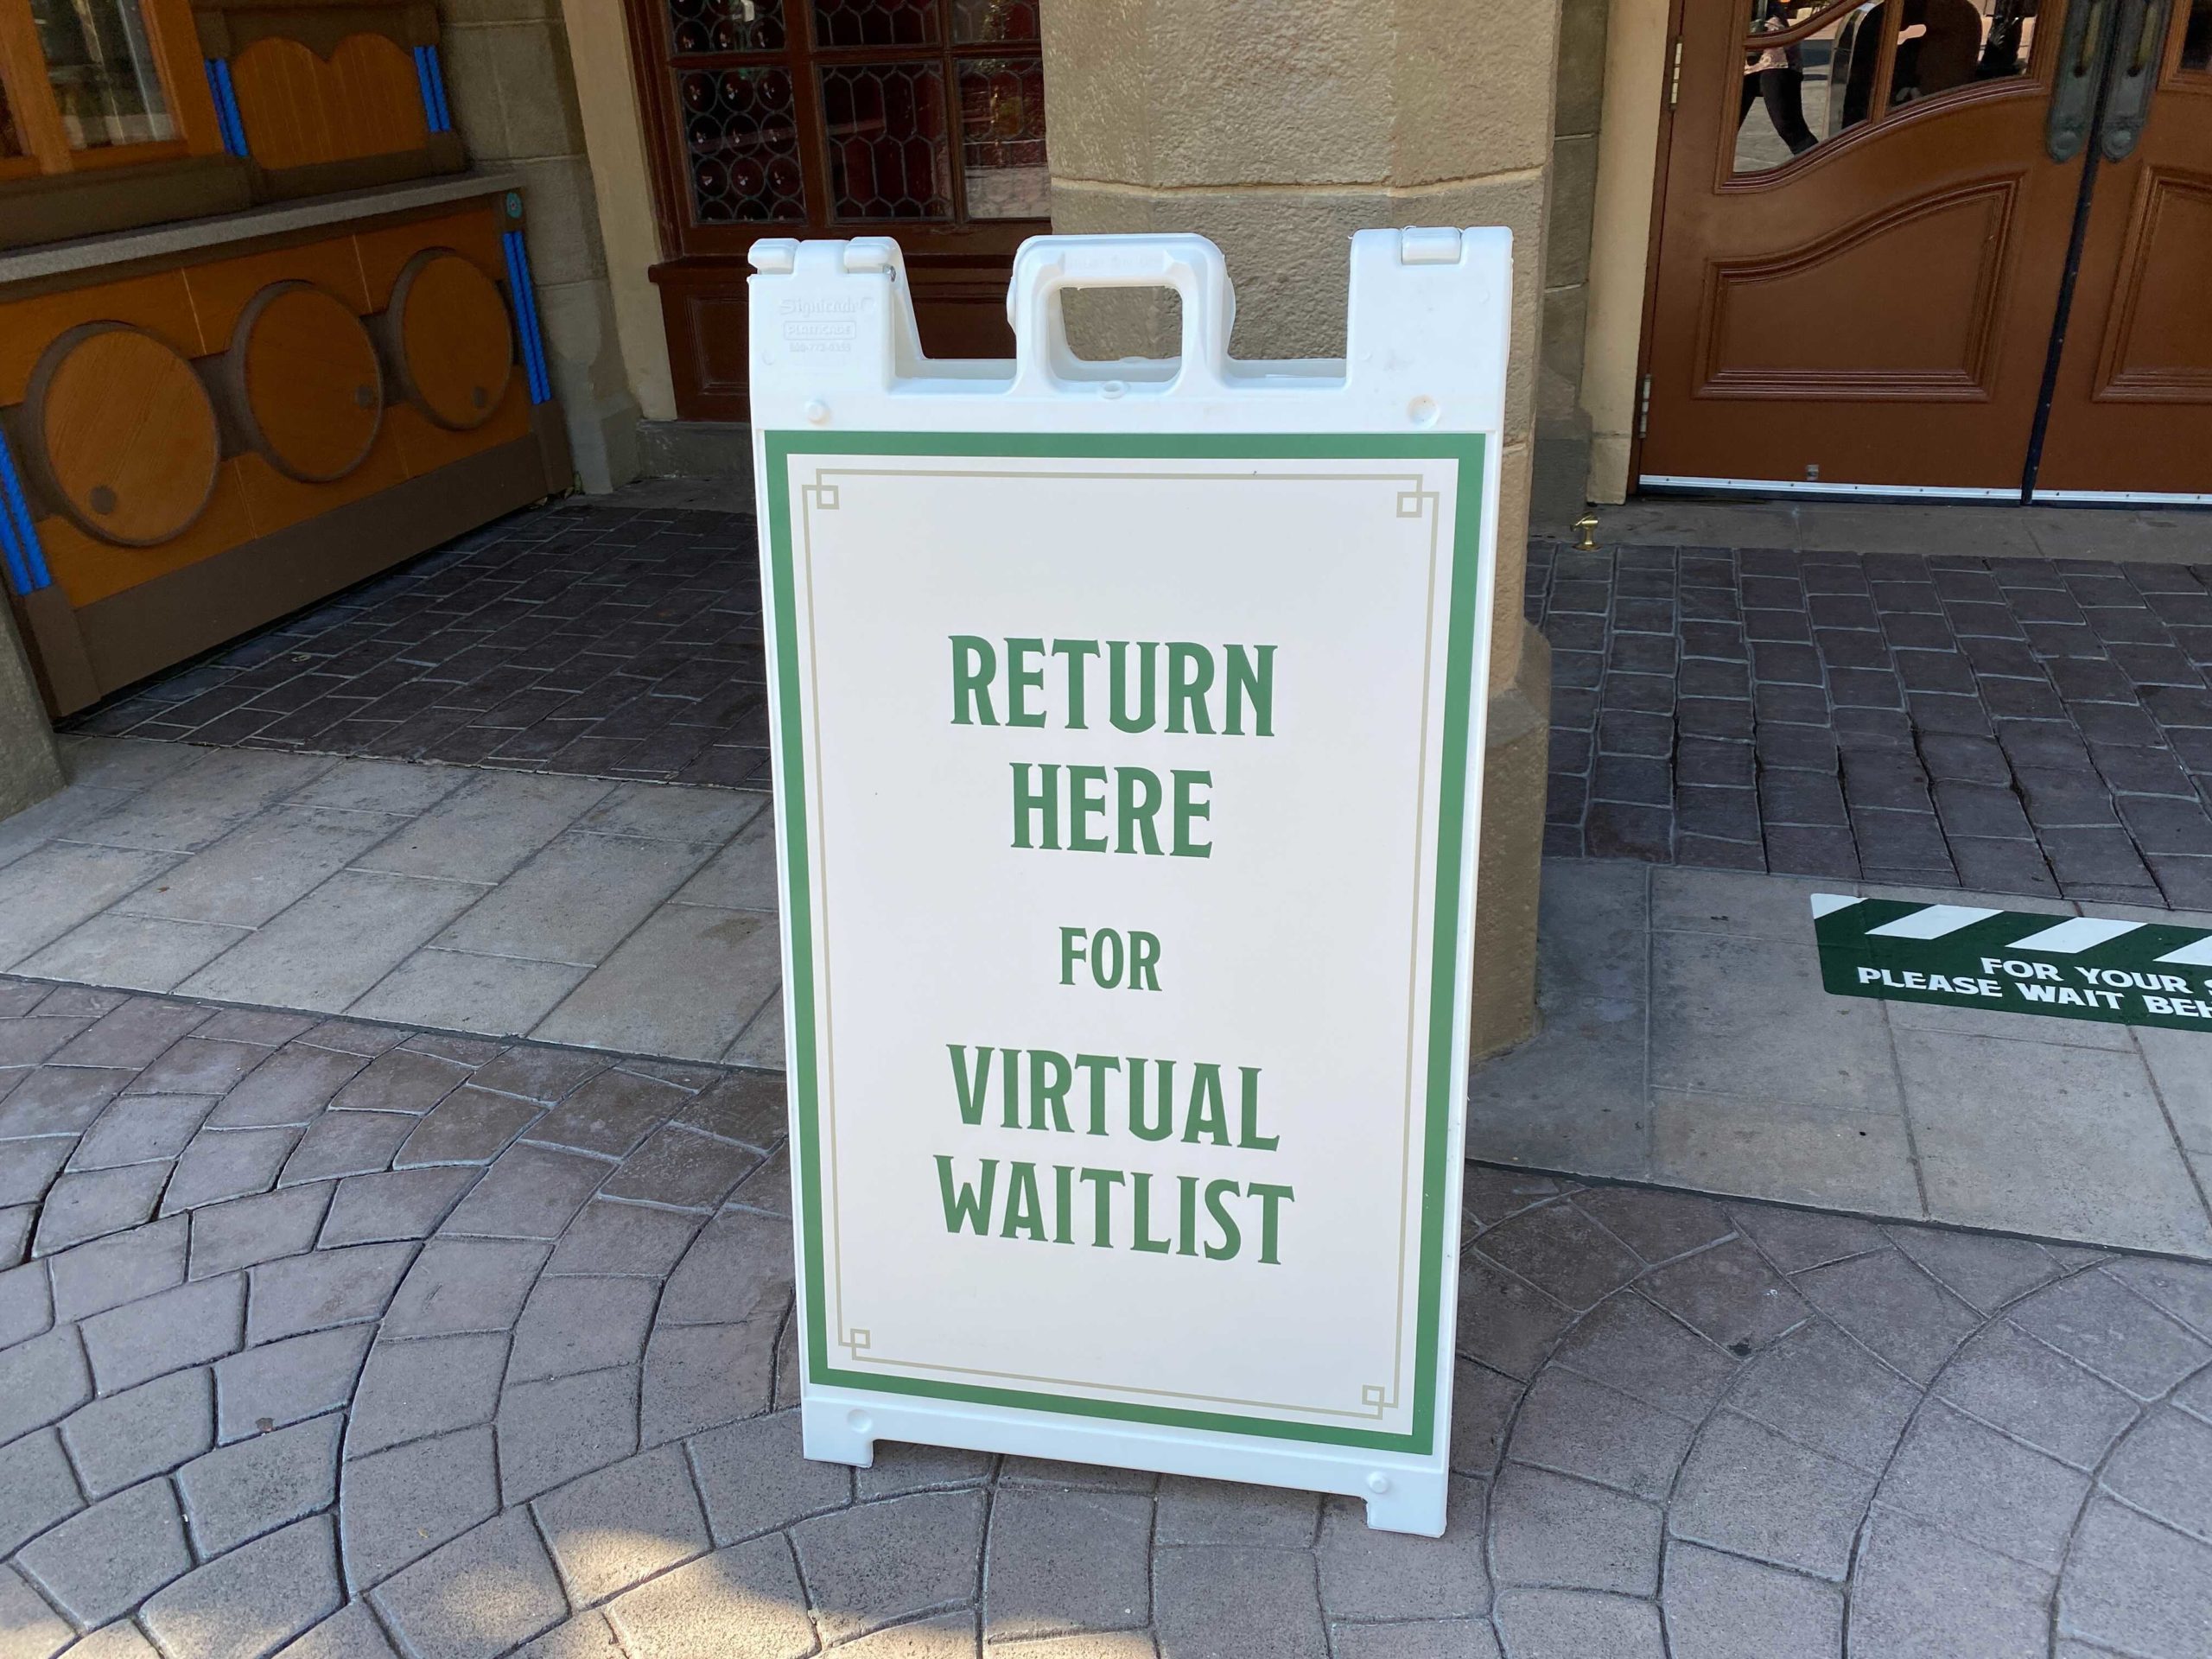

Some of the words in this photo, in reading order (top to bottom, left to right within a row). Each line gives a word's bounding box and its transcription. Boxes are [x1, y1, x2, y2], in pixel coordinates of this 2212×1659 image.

[948, 635, 1278, 737] RETURN
[1009, 762, 1213, 859] HERE
[1058, 926, 1162, 992] FOR
[1858, 967, 2003, 997] PLEASE
[2014, 982, 2125, 1010] WAIT
[1980, 957, 2063, 982] FOR
[2075, 966, 2194, 994] YOUR
[945, 1044, 1281, 1152] VIRTUAL
[932, 1154, 1295, 1265] WAITLIST
